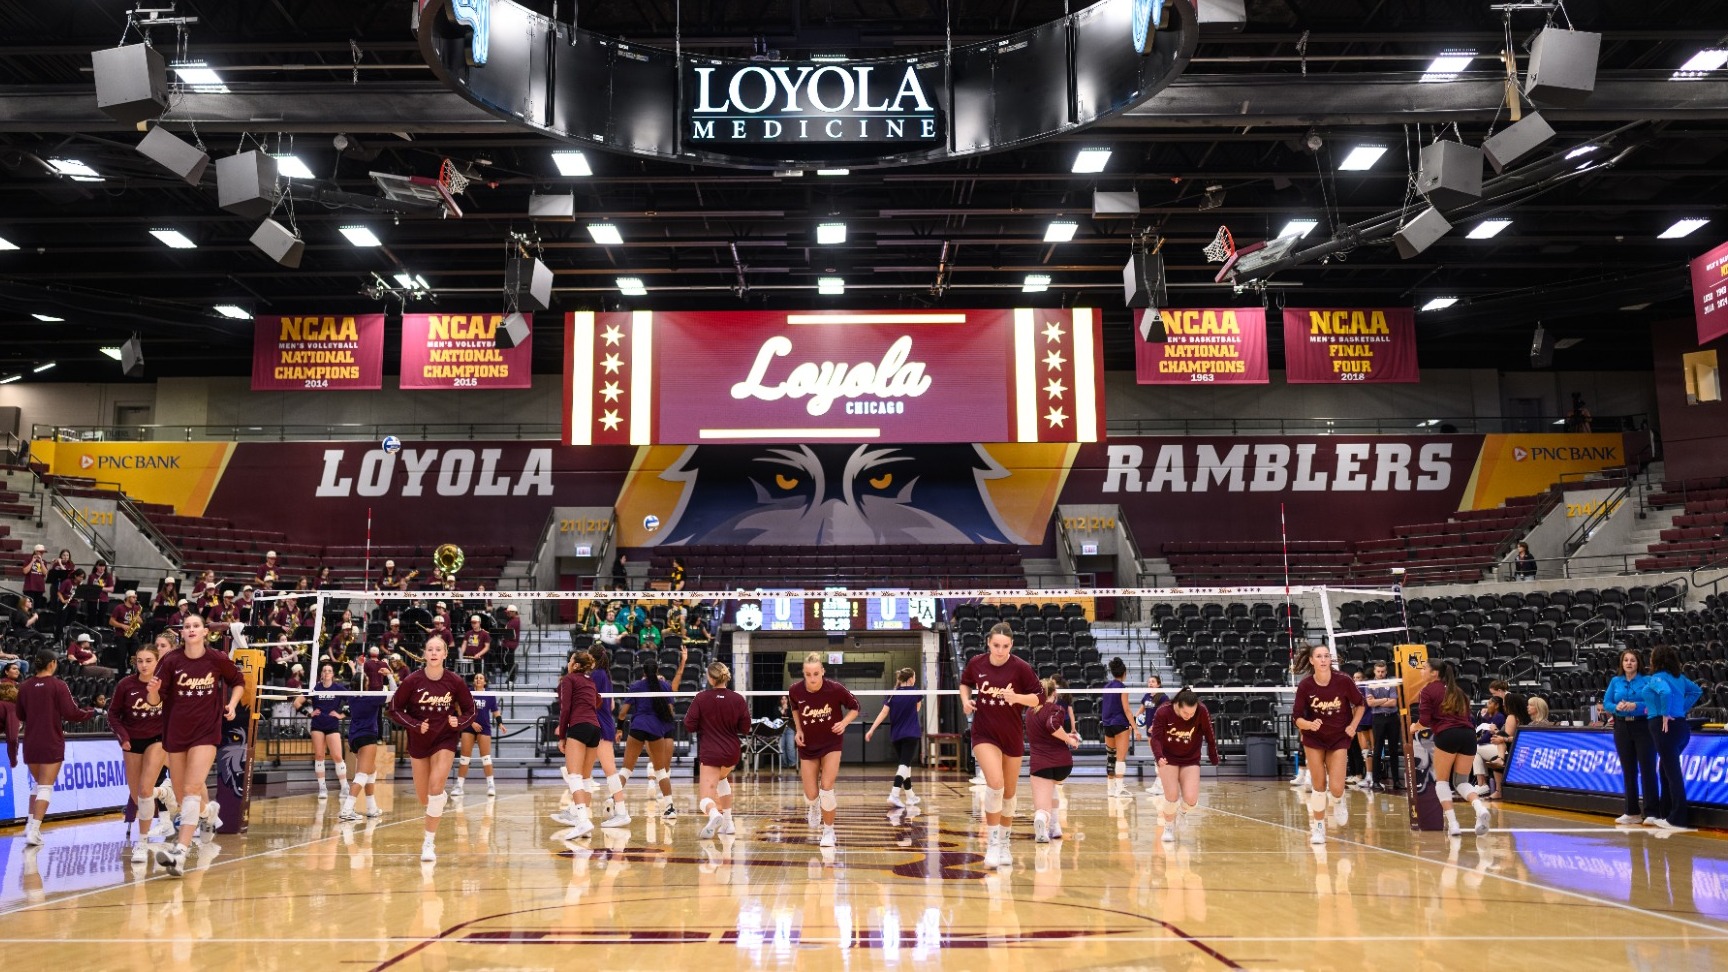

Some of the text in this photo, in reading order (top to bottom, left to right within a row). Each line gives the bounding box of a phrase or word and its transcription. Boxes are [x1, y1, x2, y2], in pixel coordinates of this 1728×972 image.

[693, 66, 934, 113] LOYOLA
[693, 120, 936, 139] MEDICINE
[280, 317, 358, 340] NCAA
[1161, 311, 1240, 334] NCAA
[1309, 311, 1389, 334] NCAA
[281, 351, 354, 363] NATIONAL
[429, 349, 503, 362] NATIONAL
[1164, 345, 1239, 358] NATIONAL
[1329, 345, 1373, 357] FINAL
[274, 366, 360, 379] CHAMPIONS
[423, 365, 509, 378] CHAMPIONS
[1159, 361, 1245, 373] CHAMPIONS
[1333, 361, 1372, 373] FOUR
[453, 378, 477, 386] 2015
[730, 335, 932, 416] Loyola
[1191, 374, 1214, 382] 1963
[1341, 373, 1365, 381] 2018
[304, 380, 328, 388] 2014
[845, 401, 904, 415] CHICAGO
[1531, 447, 1617, 461] PNC BANK
[98, 455, 181, 469] PNC BANK
[1102, 443, 1453, 493] RAMBLERS
[315, 448, 554, 497] LOYOLA
[177, 672, 215, 689] Loyola
[1311, 696, 1341, 710] Loyola
[1530, 747, 1568, 770] CAN'T
[1566, 749, 1605, 773] STOP
[53, 760, 128, 792] 1.800.GAM
